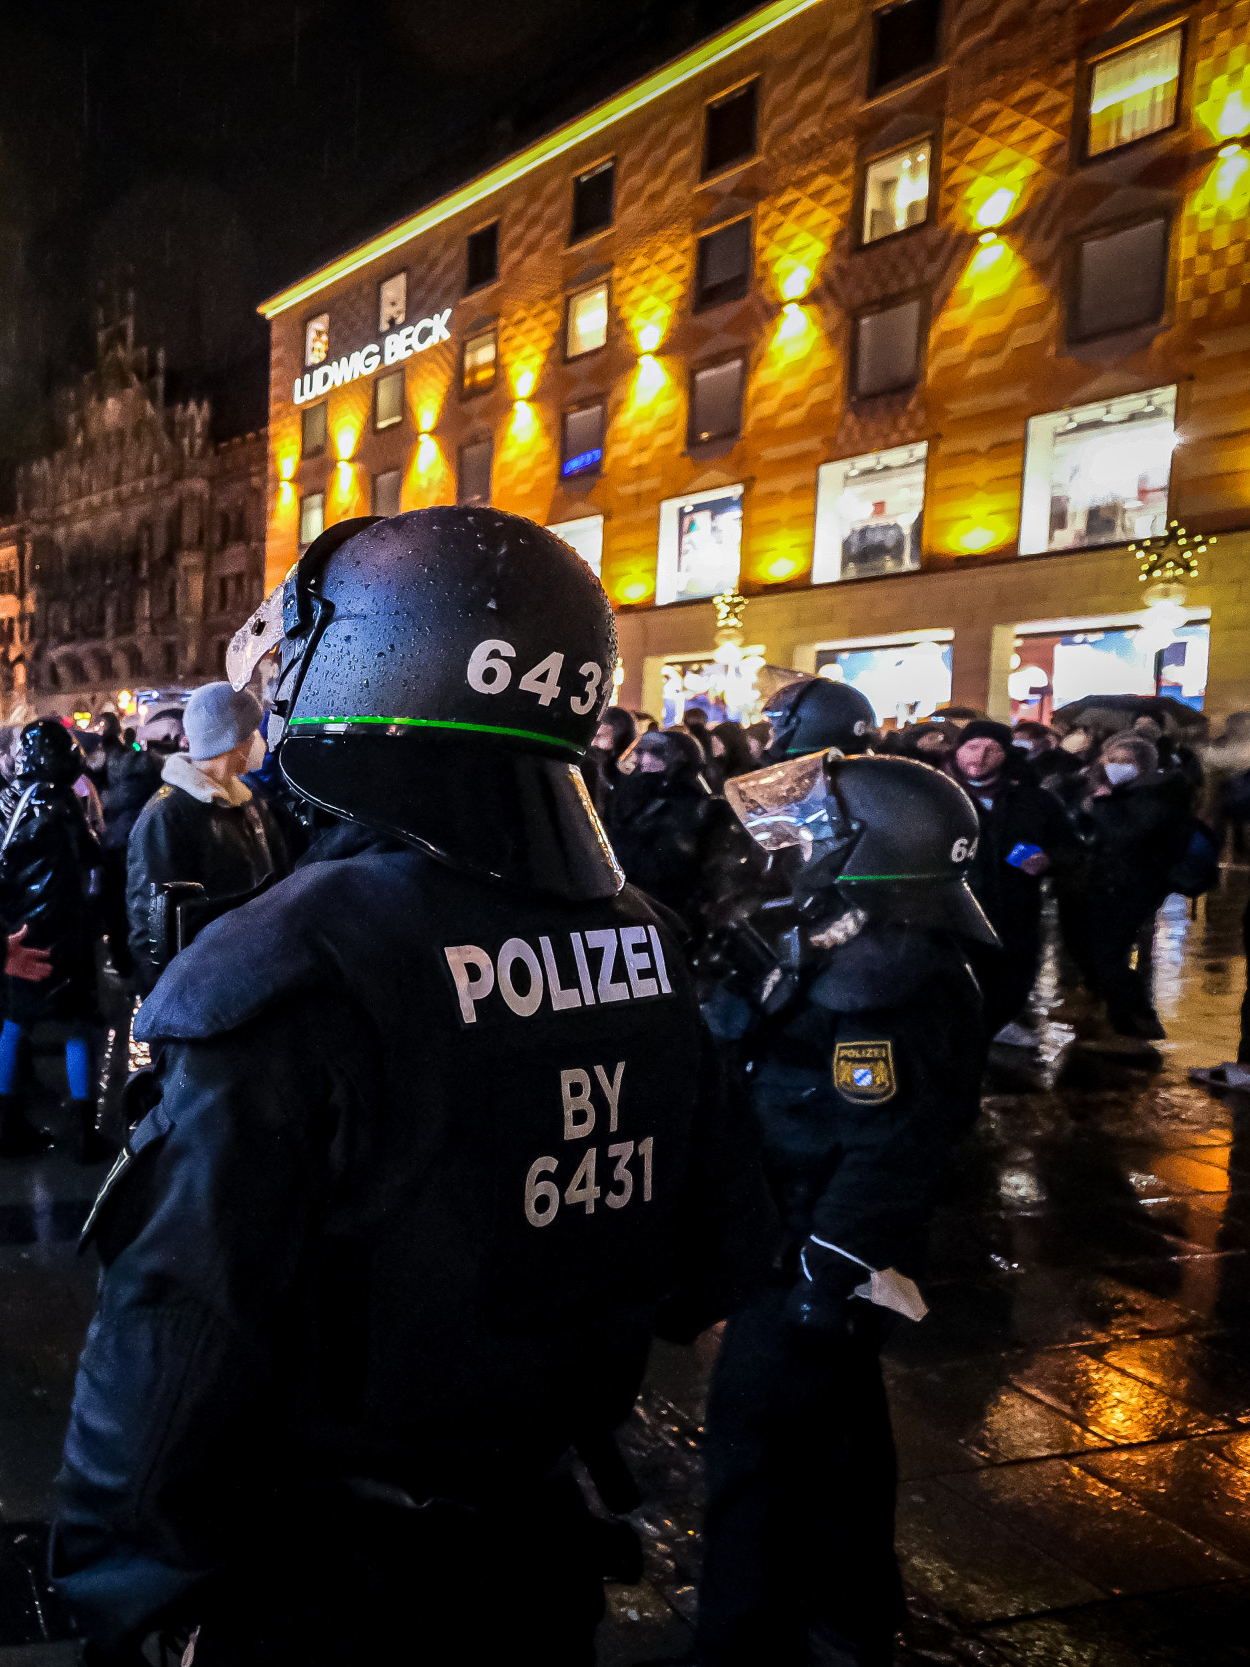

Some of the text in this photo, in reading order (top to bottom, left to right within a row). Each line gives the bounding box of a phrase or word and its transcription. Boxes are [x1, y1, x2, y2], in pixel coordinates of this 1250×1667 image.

[293, 308, 452, 405] LUDWIG BECK
[444, 925, 672, 1024] POLIZEI
[839, 1047, 886, 1059] POLIZEI
[560, 1061, 626, 1140] BY
[524, 1136, 654, 1228] 6431
